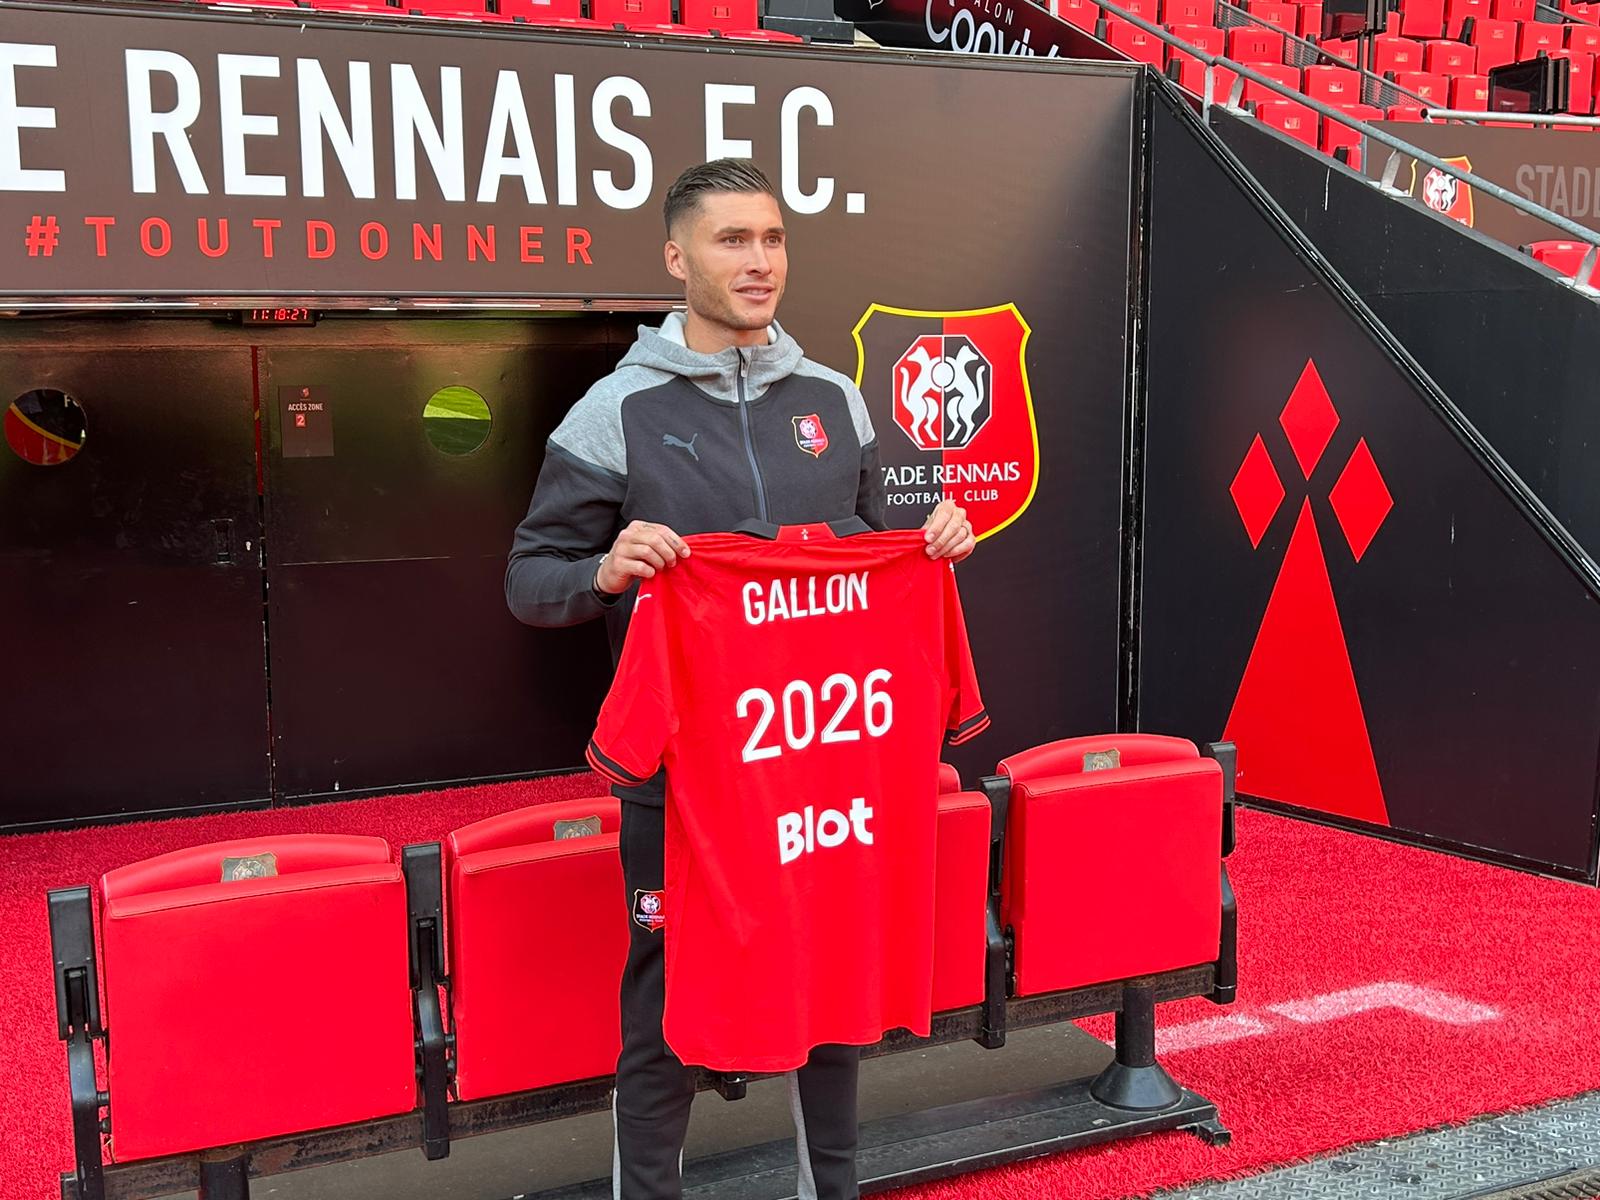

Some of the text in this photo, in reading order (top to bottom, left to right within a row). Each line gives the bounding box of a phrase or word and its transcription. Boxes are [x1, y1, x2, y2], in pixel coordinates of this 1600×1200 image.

[125, 48, 654, 210] RENNAIS
[252, 308, 308, 321] 11:18:27
[308, 403, 323, 411] ZONE
[881, 462, 1020, 486] ADE RENNAIS
[964, 489, 999, 502] CLUB
[742, 571, 869, 626] GALLON
[736, 668, 893, 763] 2026
[777, 797, 874, 865] Blot
